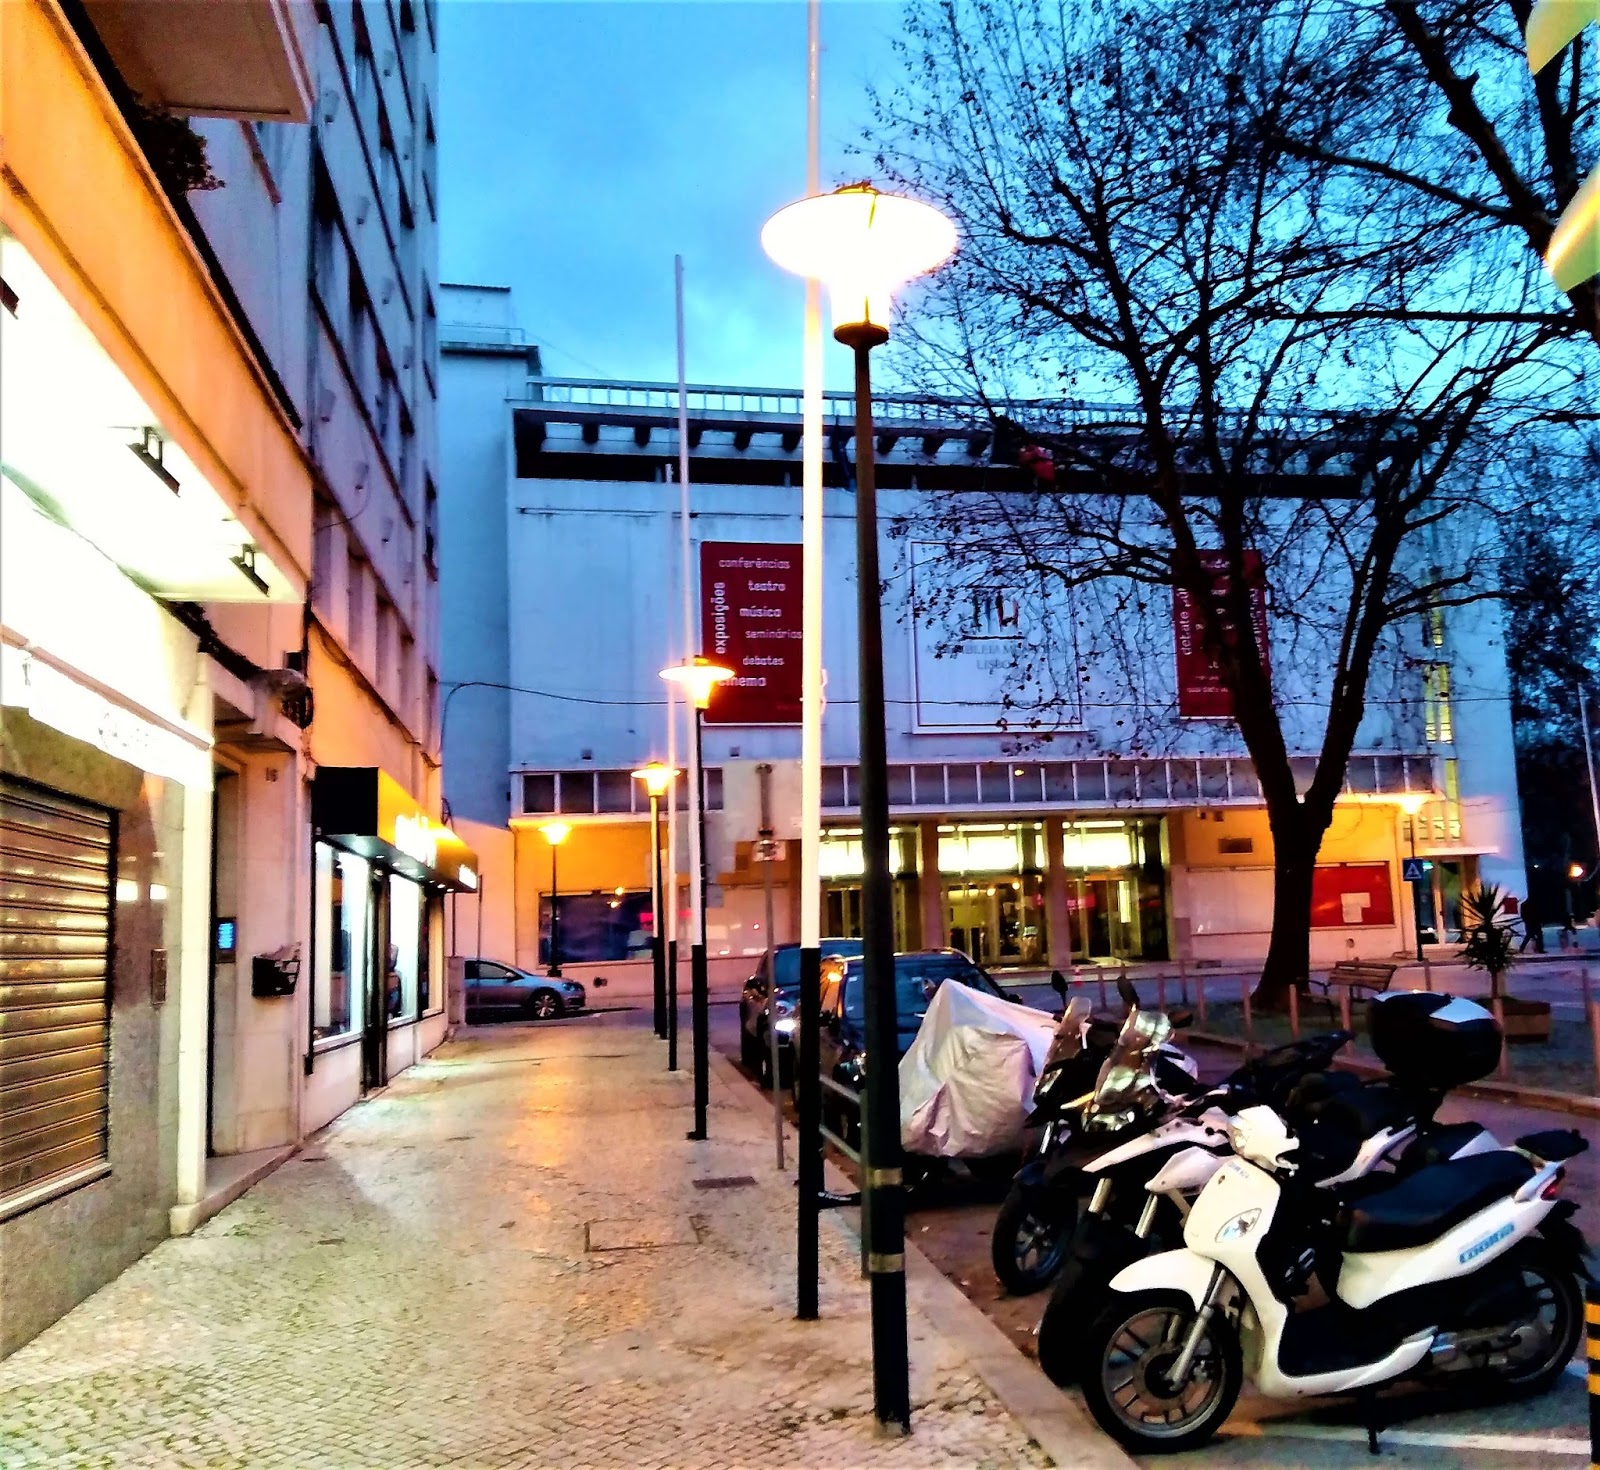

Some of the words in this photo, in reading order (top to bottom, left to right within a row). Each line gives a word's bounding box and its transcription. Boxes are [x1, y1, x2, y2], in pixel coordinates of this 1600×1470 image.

[718, 556, 791, 570] conferências
[748, 579, 786, 592] teatro
[739, 605, 782, 618] música
[710, 582, 731, 655] exposições
[745, 628, 802, 640] seminários
[742, 655, 785, 666] debates
